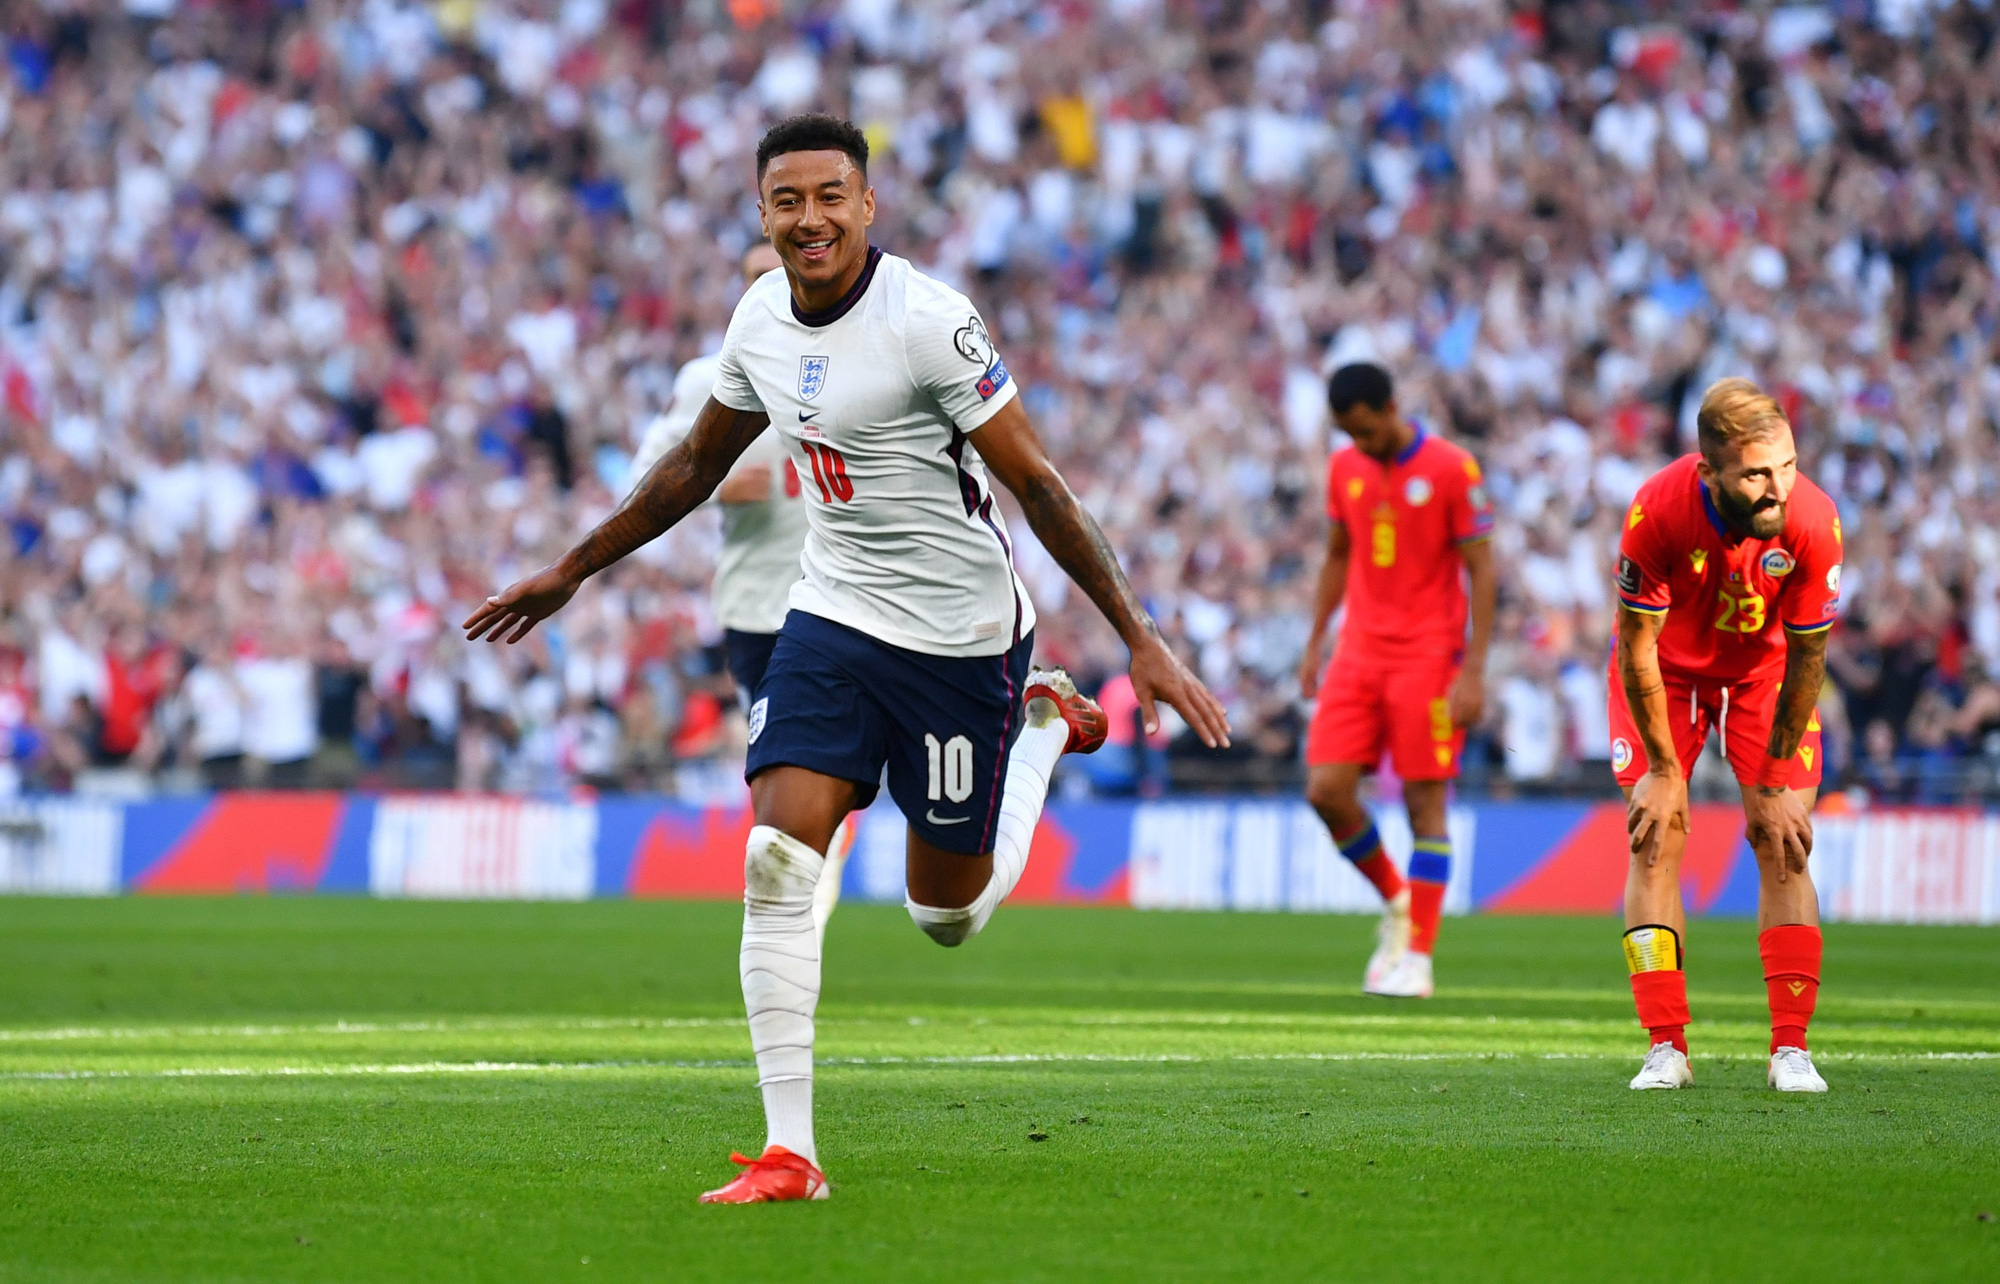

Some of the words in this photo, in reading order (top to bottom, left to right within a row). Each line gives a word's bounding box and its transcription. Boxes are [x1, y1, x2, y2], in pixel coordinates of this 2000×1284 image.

[801, 441, 854, 504] 10
[1715, 589, 1765, 633] 23
[925, 733, 973, 803] 10
